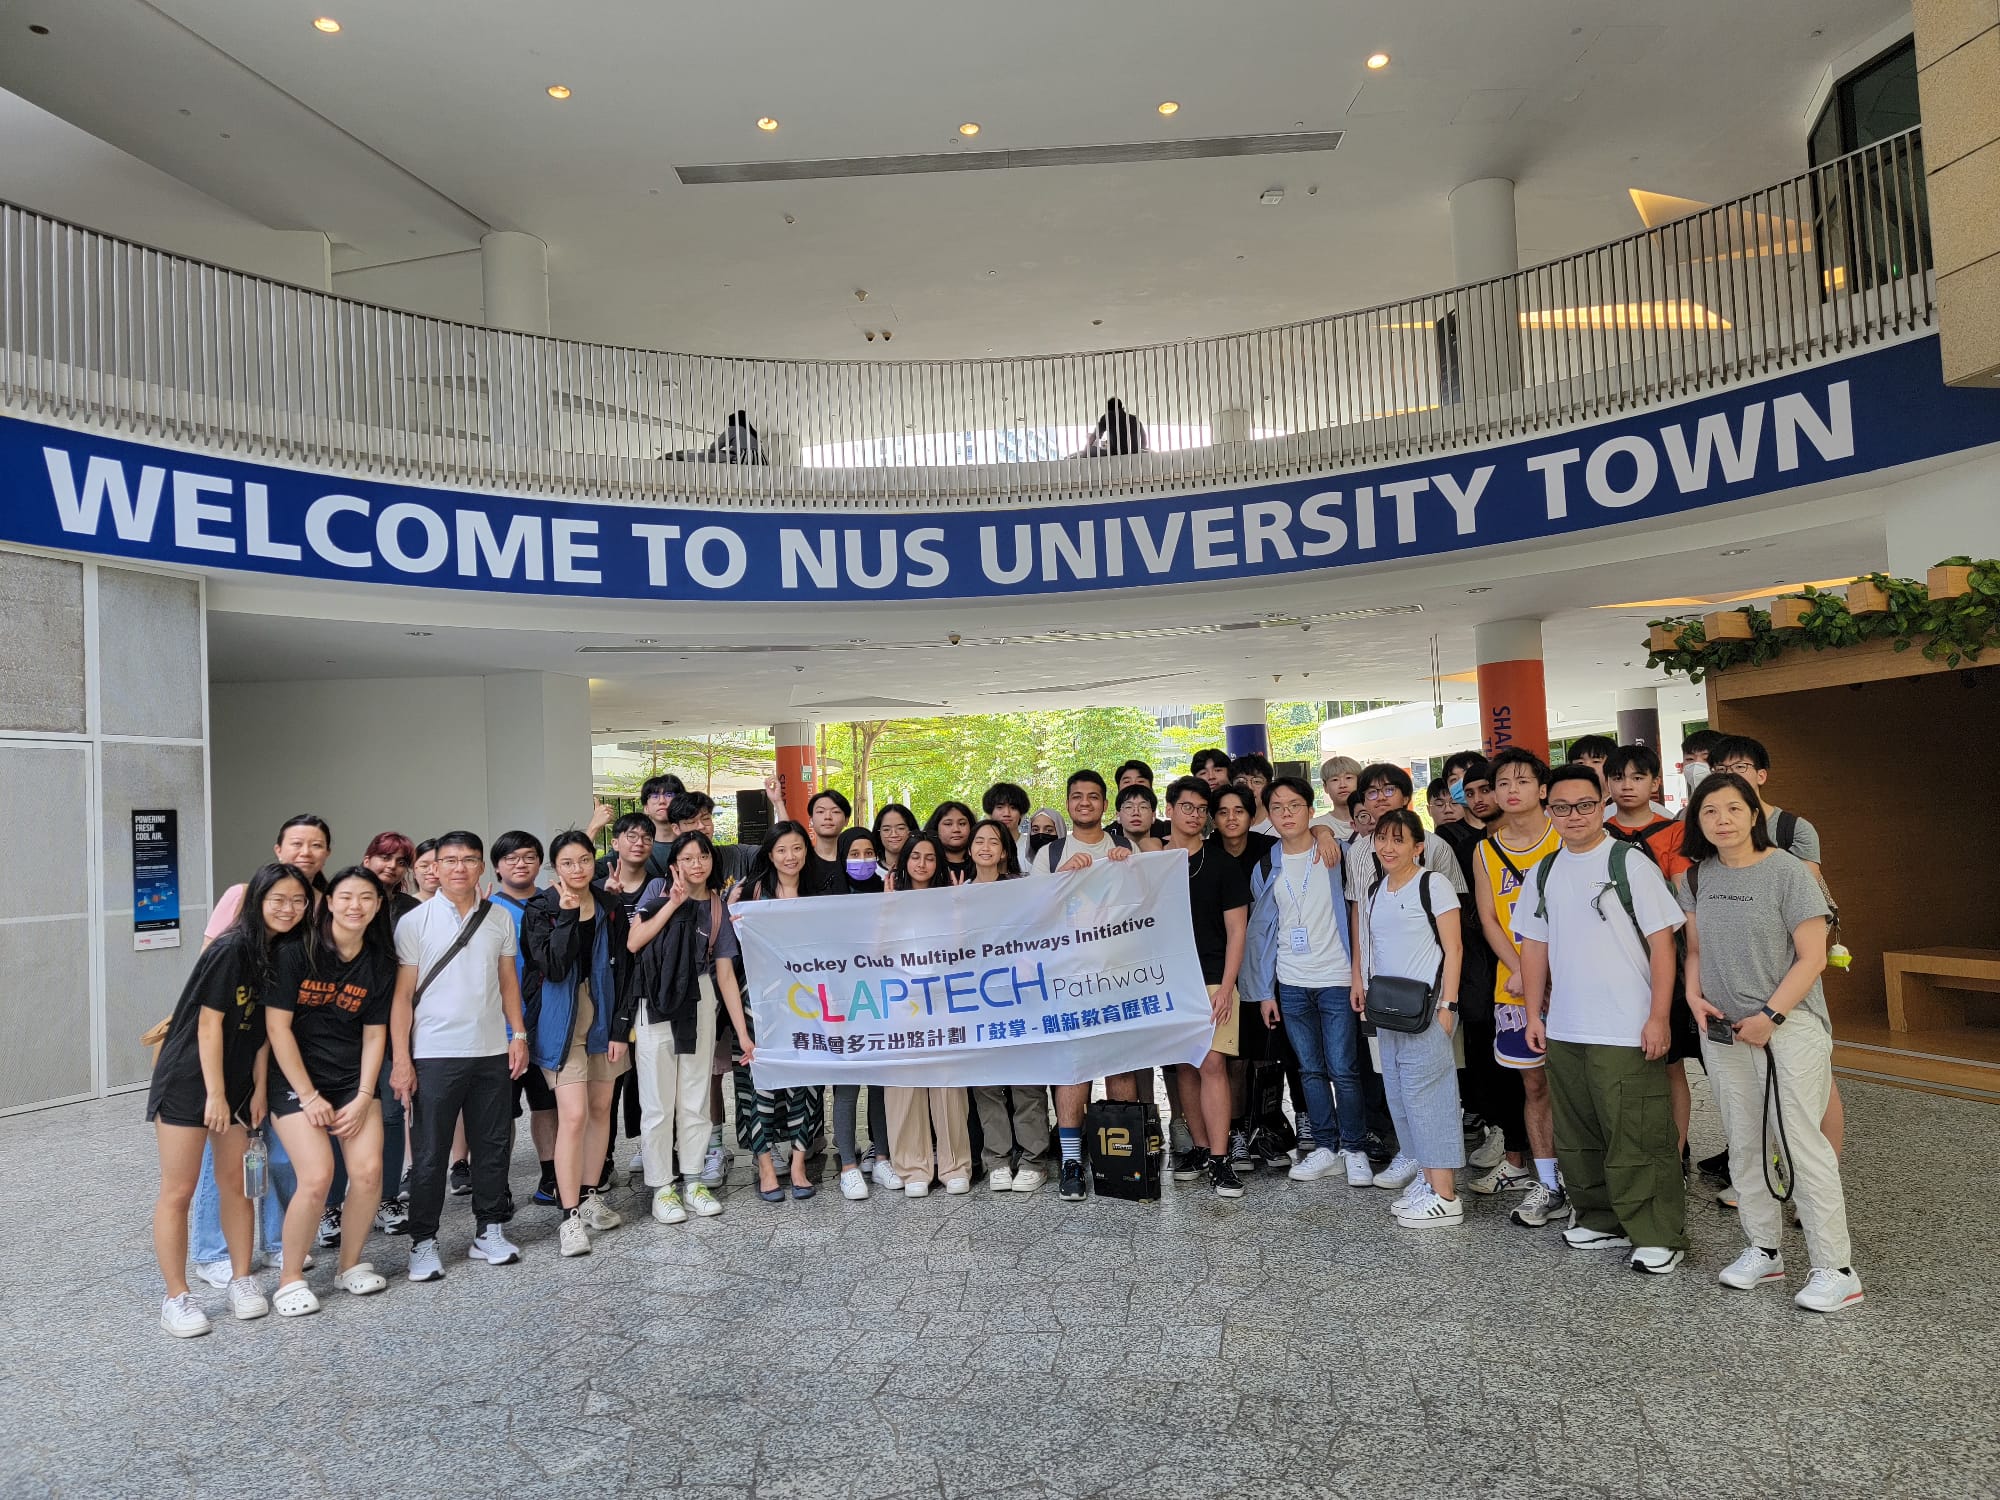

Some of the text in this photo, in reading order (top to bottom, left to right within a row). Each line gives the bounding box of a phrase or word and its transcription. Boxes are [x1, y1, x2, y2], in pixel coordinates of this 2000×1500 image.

[43, 379, 1855, 589] WELCOME TO NUS UNIVERSITY TOWN
[135, 815, 166, 823] POWERING
[135, 823, 155, 832] FRESH
[135, 832, 151, 841] COOL
[783, 915, 1156, 974] Jockey Club Multiple Pathways Initiative
[300, 979, 368, 998] HALLS NUS
[1052, 963, 1166, 1000] Pathway
[1097, 1127, 1132, 1157] 12
